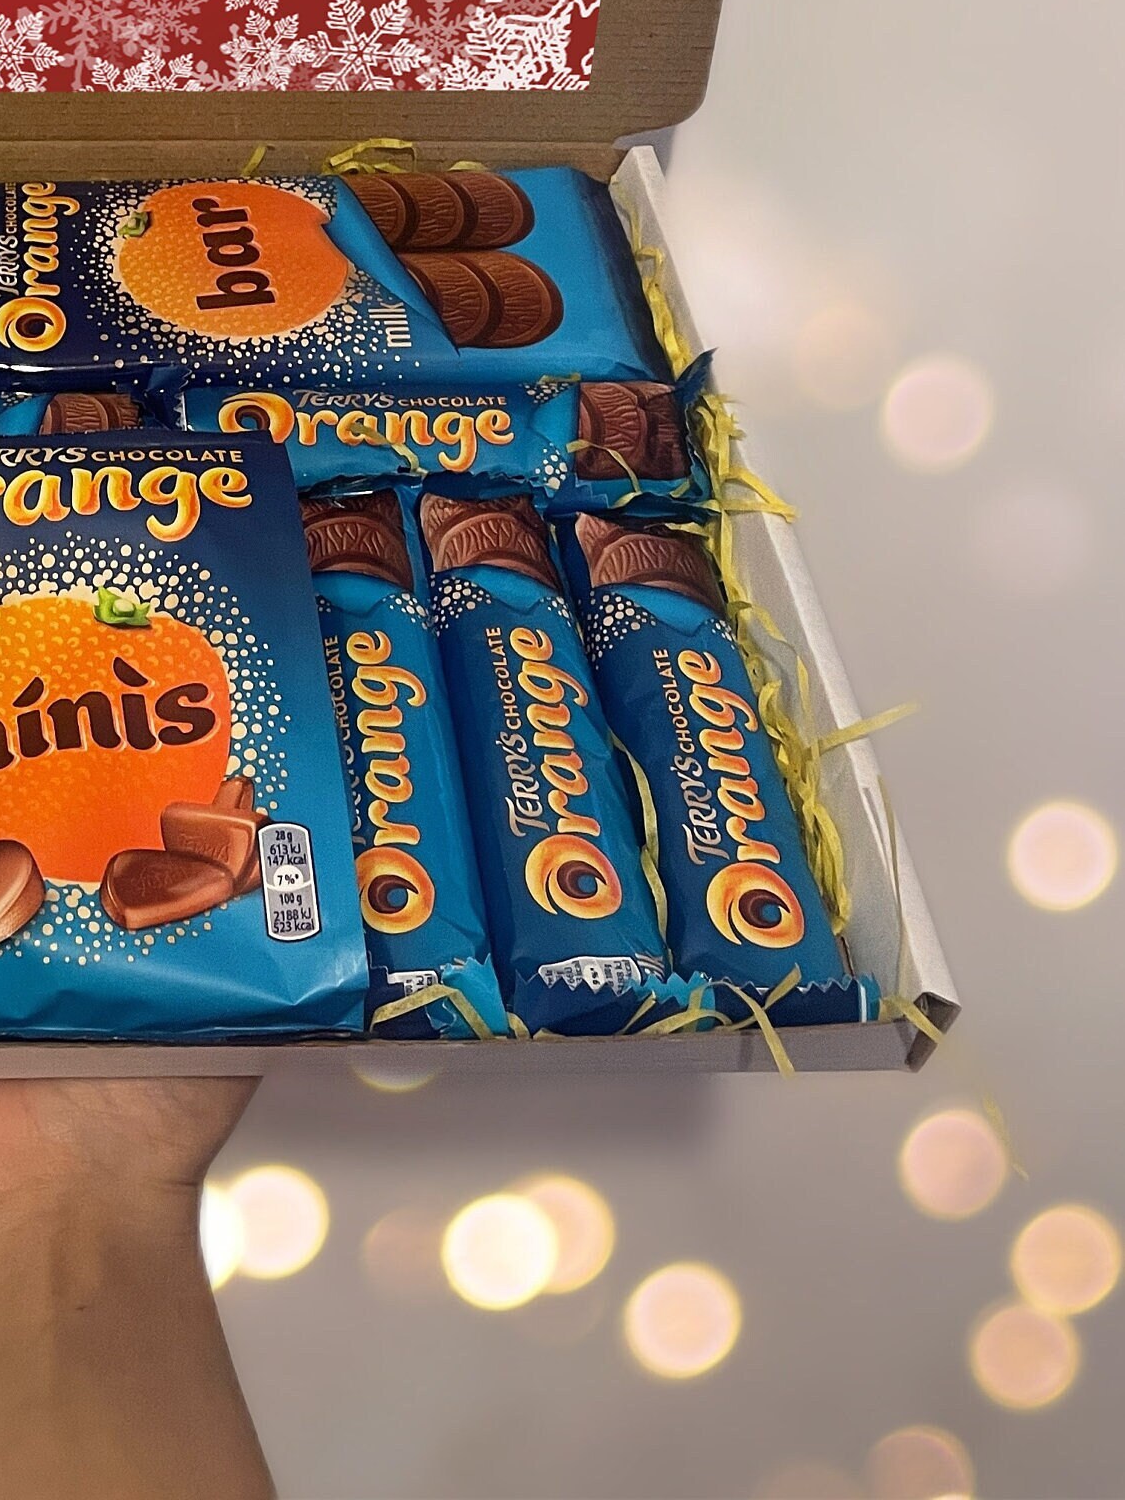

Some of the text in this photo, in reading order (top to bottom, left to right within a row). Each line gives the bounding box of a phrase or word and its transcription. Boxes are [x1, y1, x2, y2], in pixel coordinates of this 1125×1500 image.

[190, 196, 278, 311] bar
[367, 301, 412, 348] milk
[292, 389, 508, 409] TERRY'S CHOCOLATE
[218, 392, 515, 473] Orange
[91, 449, 244, 464] CHOCOLATE
[485, 626, 551, 838] TERRY'S CHOCOLATE
[509, 627, 623, 920] Orange
[652, 648, 730, 867] TERRY'S CHOCOLATE
[346, 630, 436, 934] Orange
[677, 649, 805, 949] Orange
[270, 843, 302, 855] 613 kJ
[275, 830, 293, 842] 28 g
[267, 853, 307, 866] 147 kcal
[279, 893, 303, 906] 100 g
[300, 907, 312, 920] kJ
[273, 919, 315, 933] 523 kcal
